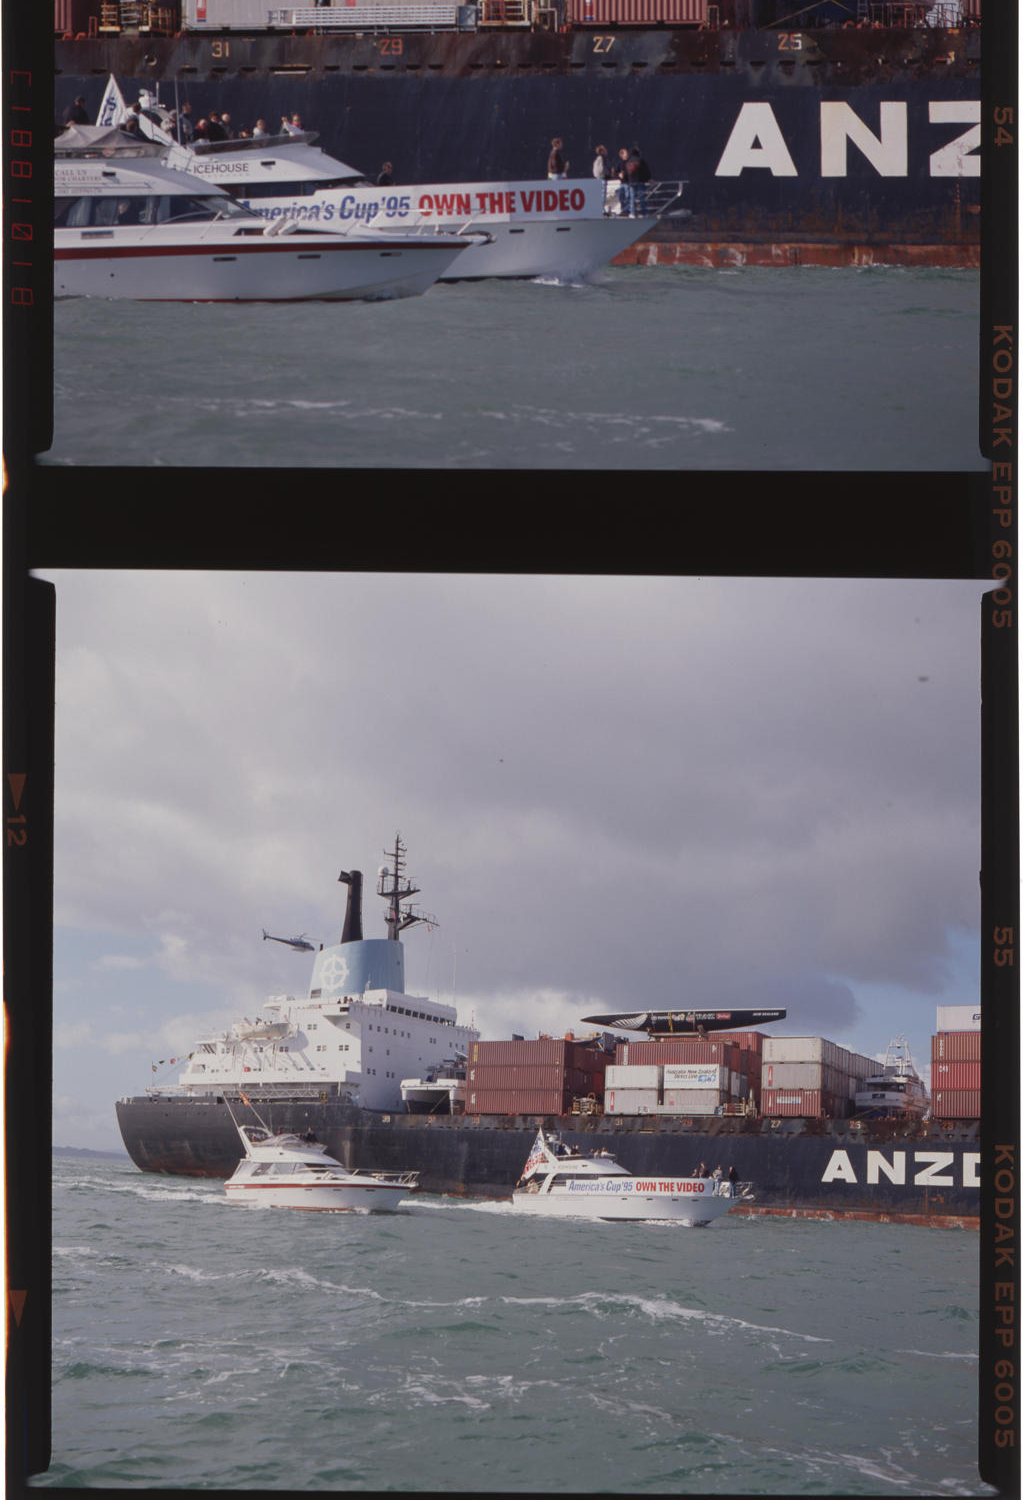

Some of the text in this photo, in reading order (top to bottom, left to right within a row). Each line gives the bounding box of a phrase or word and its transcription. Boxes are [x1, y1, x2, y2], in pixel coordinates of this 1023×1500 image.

[211, 41, 230, 58] 31
[379, 38, 403, 56] 29
[592, 35, 616, 53] 27
[777, 33, 802, 50] 25
[994, 107, 1013, 146] 54
[193, 162, 249, 174] ICEHOUSE
[243, 188, 586, 224] merica's Cup '95 OWN THE VIDEO
[992, 325, 1012, 627] KODAK EPP 6005
[7, 815, 27, 846] 12
[994, 926, 1013, 966] 55
[568, 1180, 605, 1192] America's
[606, 1180, 621, 1192] Cup
[635, 1181, 656, 1192] OWN
[658, 1182, 675, 1192] THE
[676, 1182, 705, 1193] VIDEO
[995, 1144, 1014, 1447] KODAK EPP 6005
